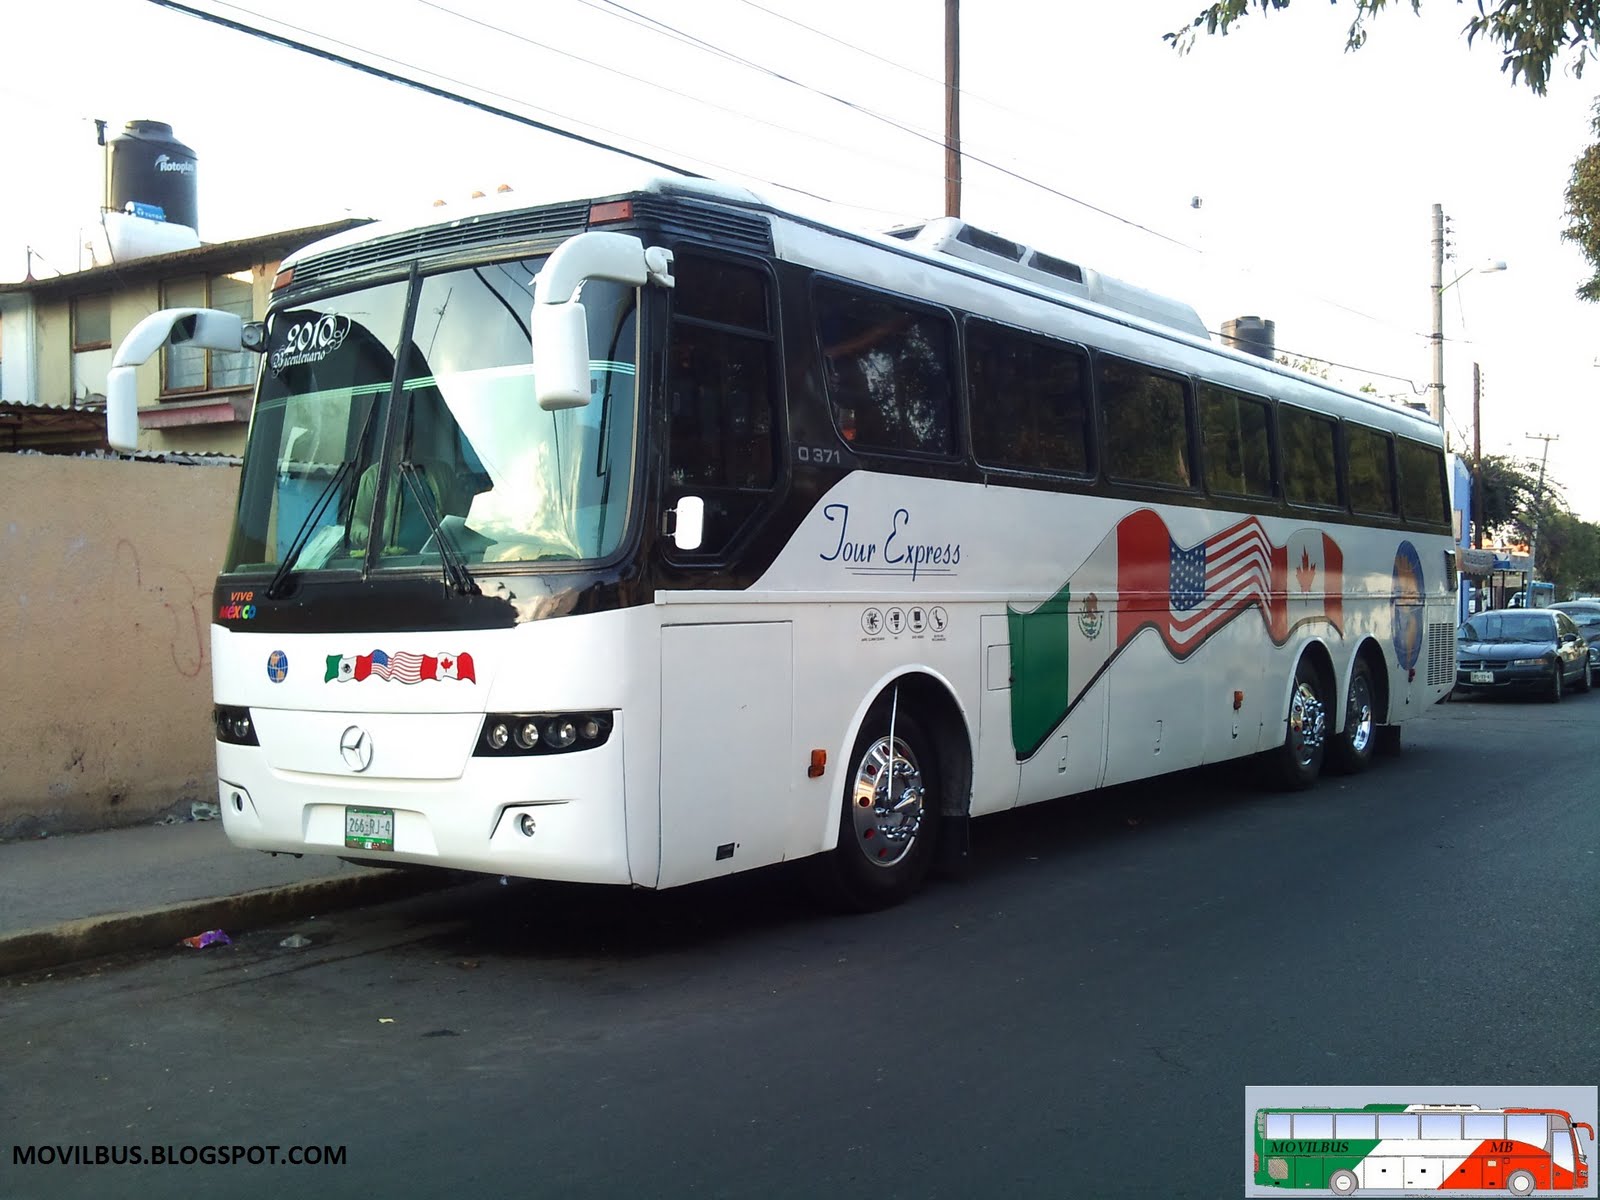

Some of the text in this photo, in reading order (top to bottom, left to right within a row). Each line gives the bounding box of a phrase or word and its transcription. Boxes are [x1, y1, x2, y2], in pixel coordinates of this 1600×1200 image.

[286, 321, 335, 353] 2010
[813, 449, 841, 464] 371
[820, 503, 961, 582] Tour Express
